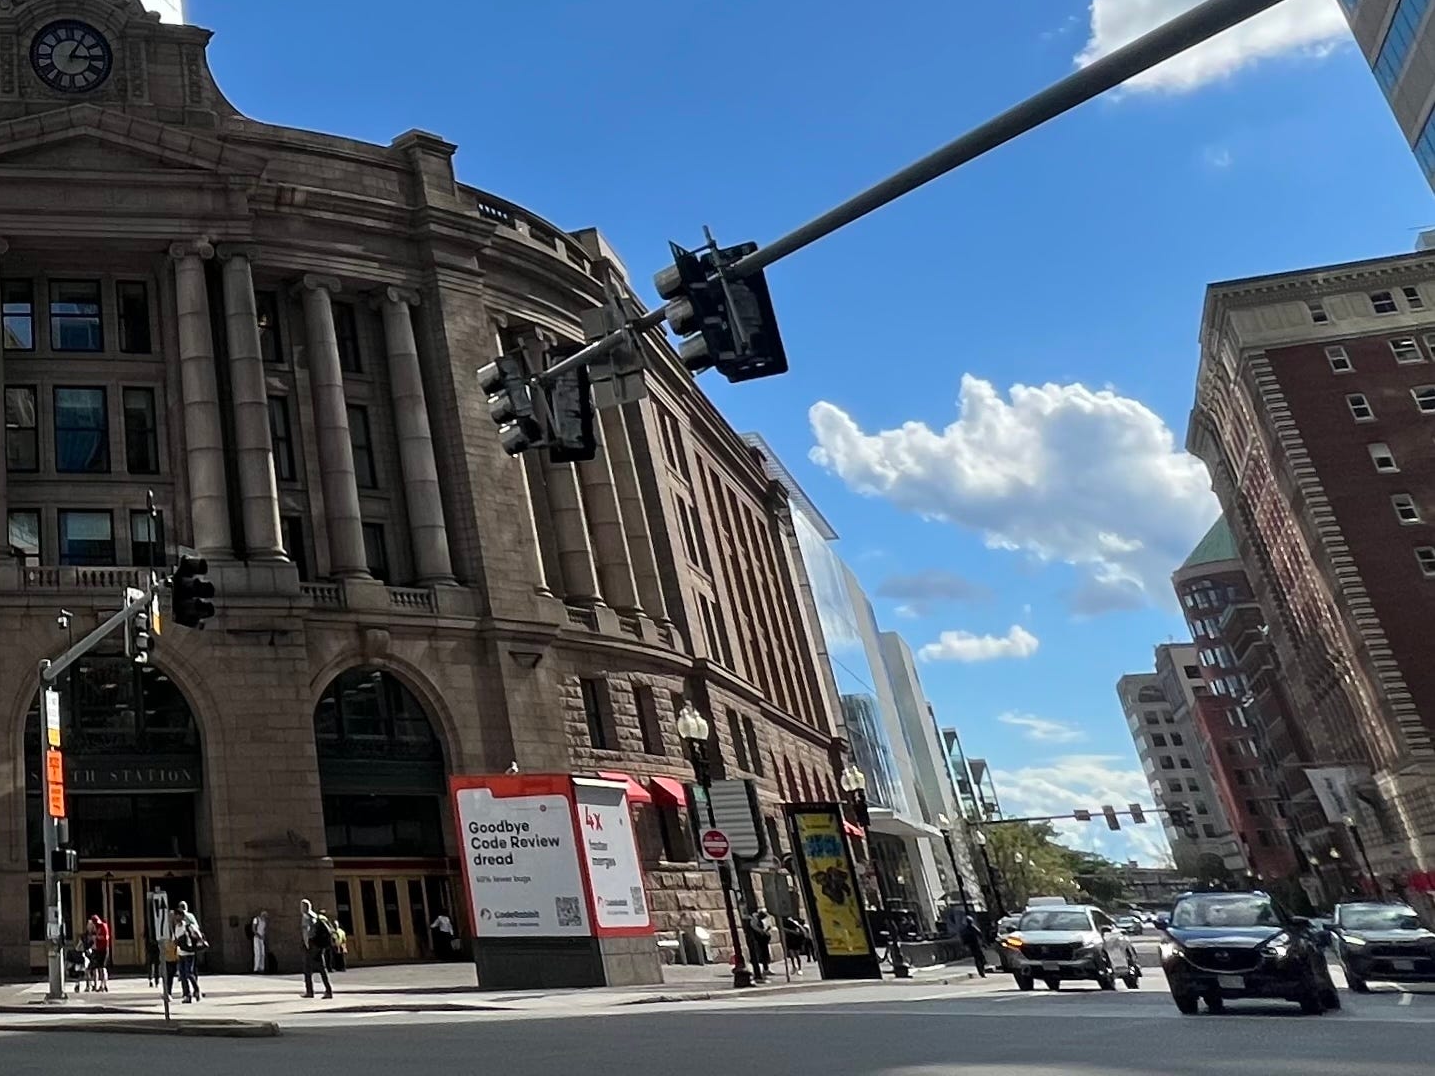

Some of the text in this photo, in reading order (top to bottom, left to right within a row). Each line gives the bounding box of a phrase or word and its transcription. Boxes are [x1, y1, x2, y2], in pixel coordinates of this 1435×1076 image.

[31, 769, 192, 783] STH STATION
[468, 819, 530, 835] Goodbye
[470, 834, 560, 850] Code Review
[473, 852, 514, 866] dread
